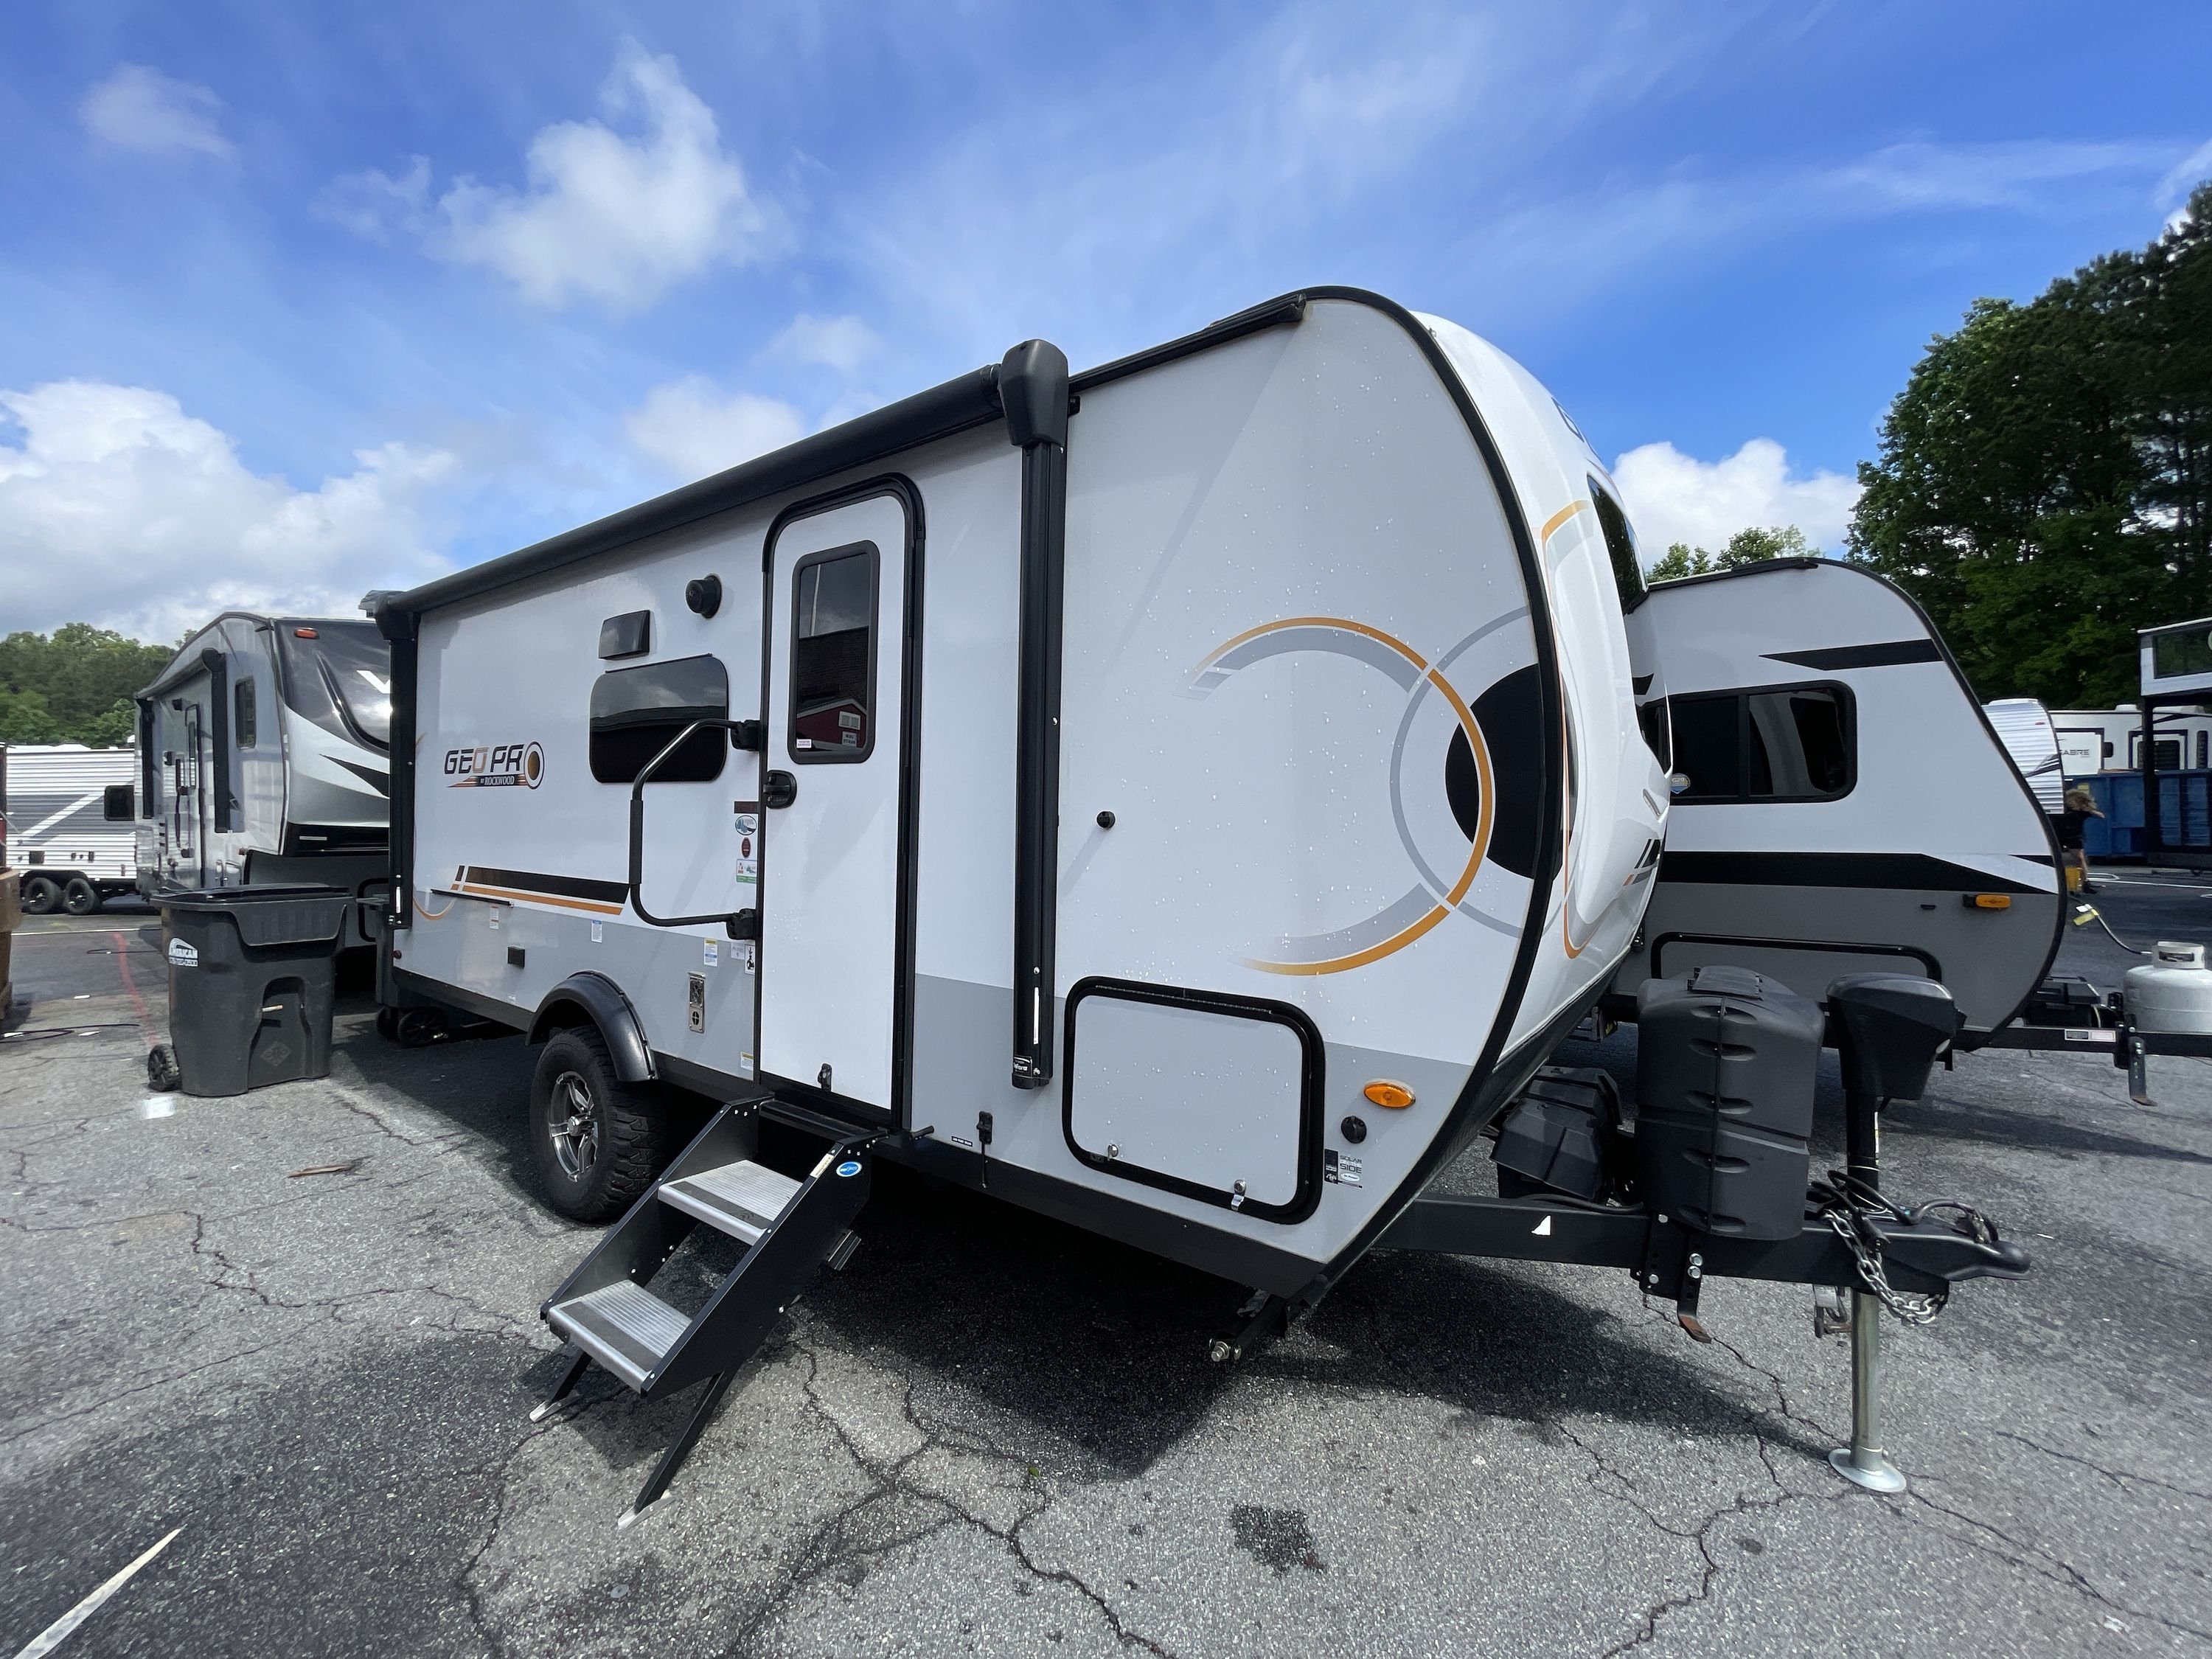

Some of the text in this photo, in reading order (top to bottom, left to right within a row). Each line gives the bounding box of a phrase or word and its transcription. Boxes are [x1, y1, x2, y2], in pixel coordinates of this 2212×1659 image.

[444, 741, 545, 790] GEO PRO
[484, 776, 515, 786] ROCKWOOD
[1340, 1155, 1363, 1164] SOLAR
[1340, 1164, 1363, 1174] SIDE
